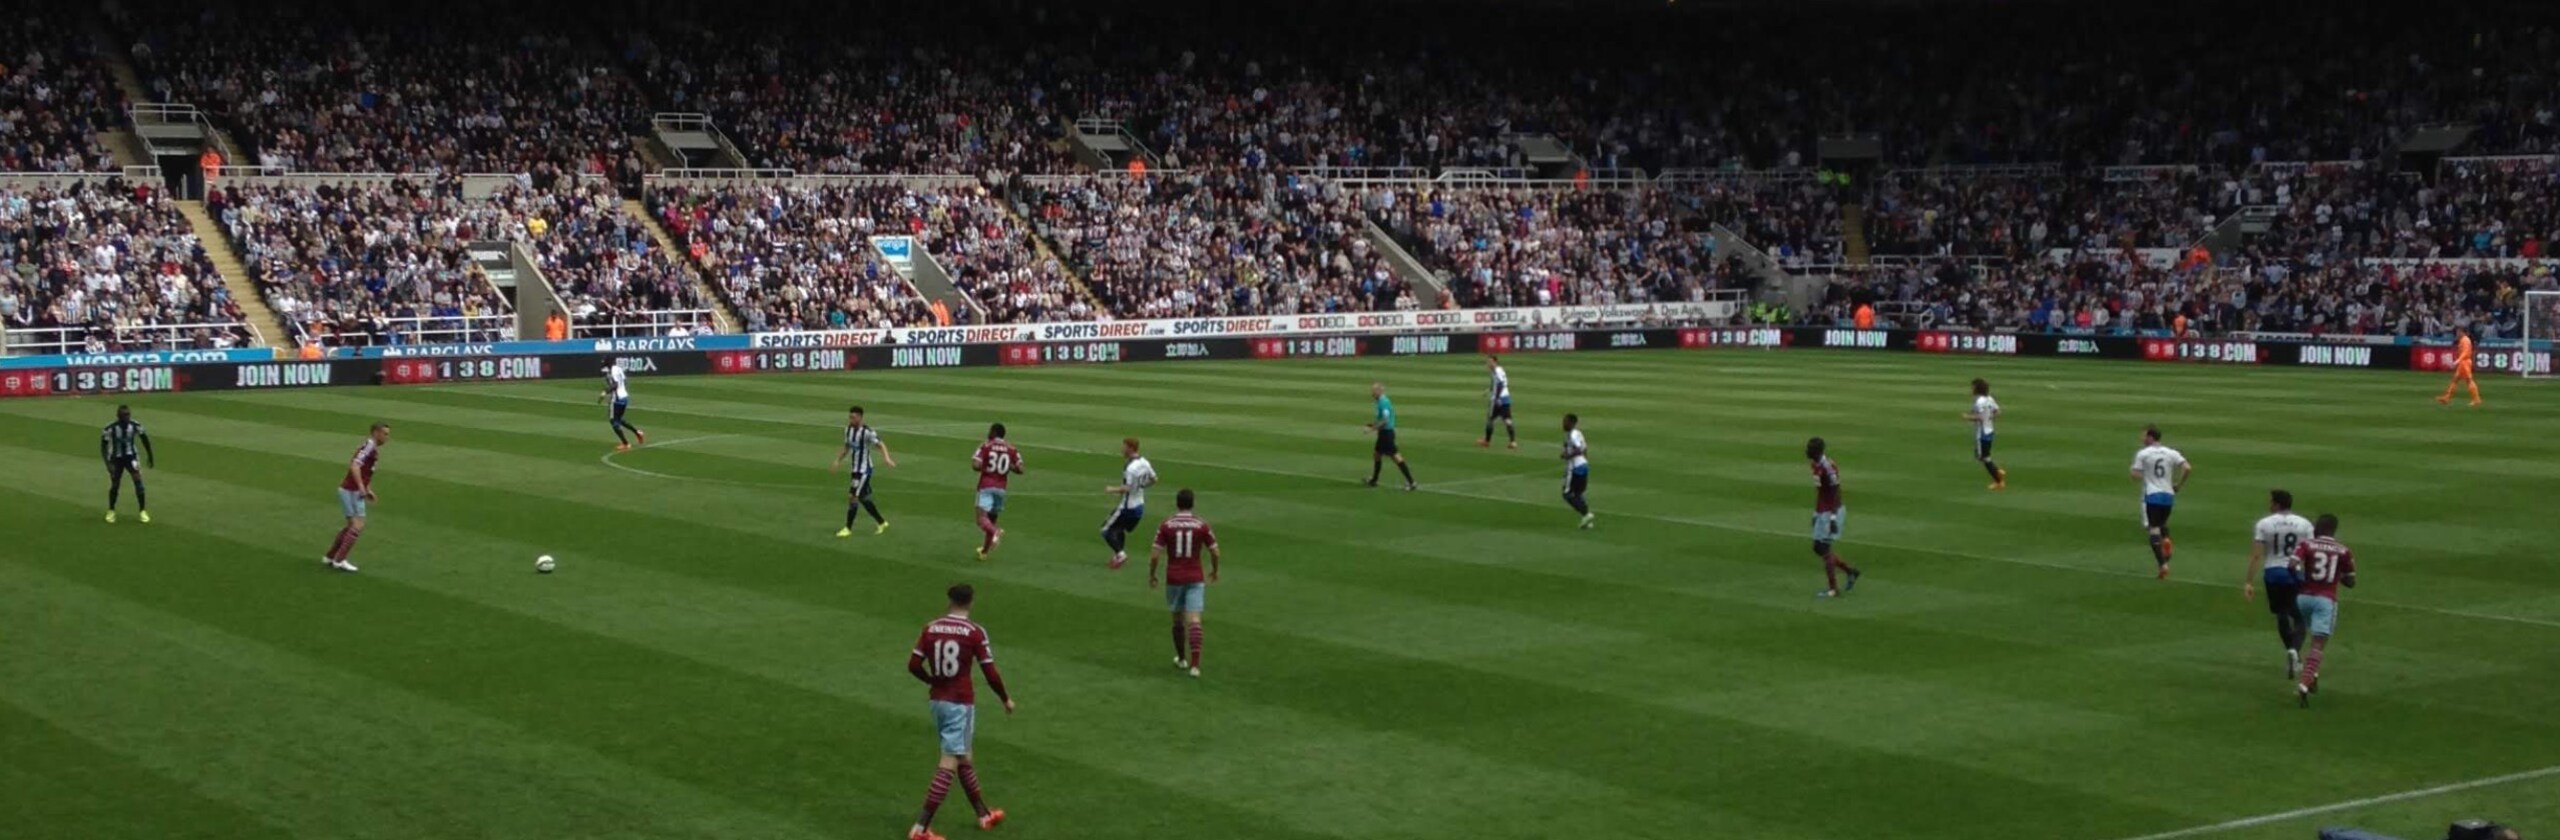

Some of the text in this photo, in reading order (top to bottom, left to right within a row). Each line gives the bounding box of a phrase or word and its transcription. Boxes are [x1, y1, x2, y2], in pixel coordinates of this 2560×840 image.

[616, 337, 696, 351] BARCLAYS
[907, 327, 1031, 344] SPORTSDIRECT.CO
[1392, 336, 1448, 353] JOIN NOW
[1825, 329, 1887, 347] JOIN NOW
[891, 346, 961, 367] JOIN NOW
[2300, 345, 2370, 366] JOIN NOW
[2477, 351, 2550, 372] 38.COM
[236, 363, 331, 386] JOIN NOW
[986, 451, 1010, 475] 30
[2154, 458, 2166, 479] 6
[1175, 530, 1193, 558] 11
[2273, 532, 2298, 557] 18
[2311, 551, 2340, 583] 31
[934, 640, 960, 677] 18
